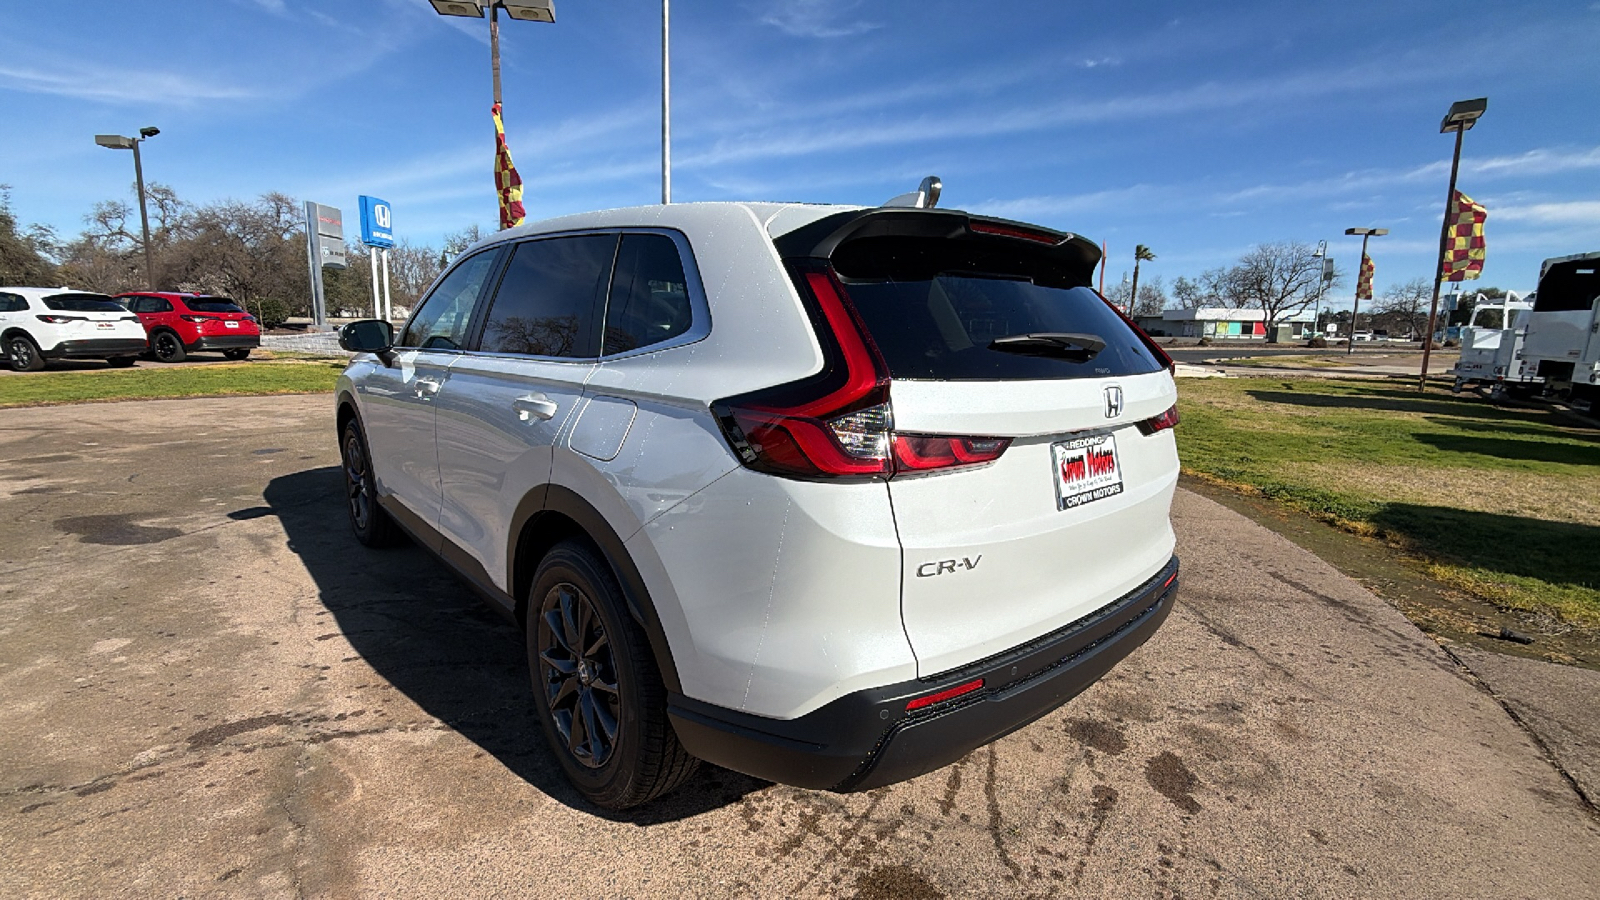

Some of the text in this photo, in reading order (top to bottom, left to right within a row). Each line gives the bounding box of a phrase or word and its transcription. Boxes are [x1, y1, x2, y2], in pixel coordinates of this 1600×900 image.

[1069, 436, 1103, 449] REDDING
[1087, 446, 1115, 478] Motors
[1066, 491, 1093, 507] CROWN
[1093, 484, 1121, 499] MOTORS
[916, 554, 982, 577] CR-V
